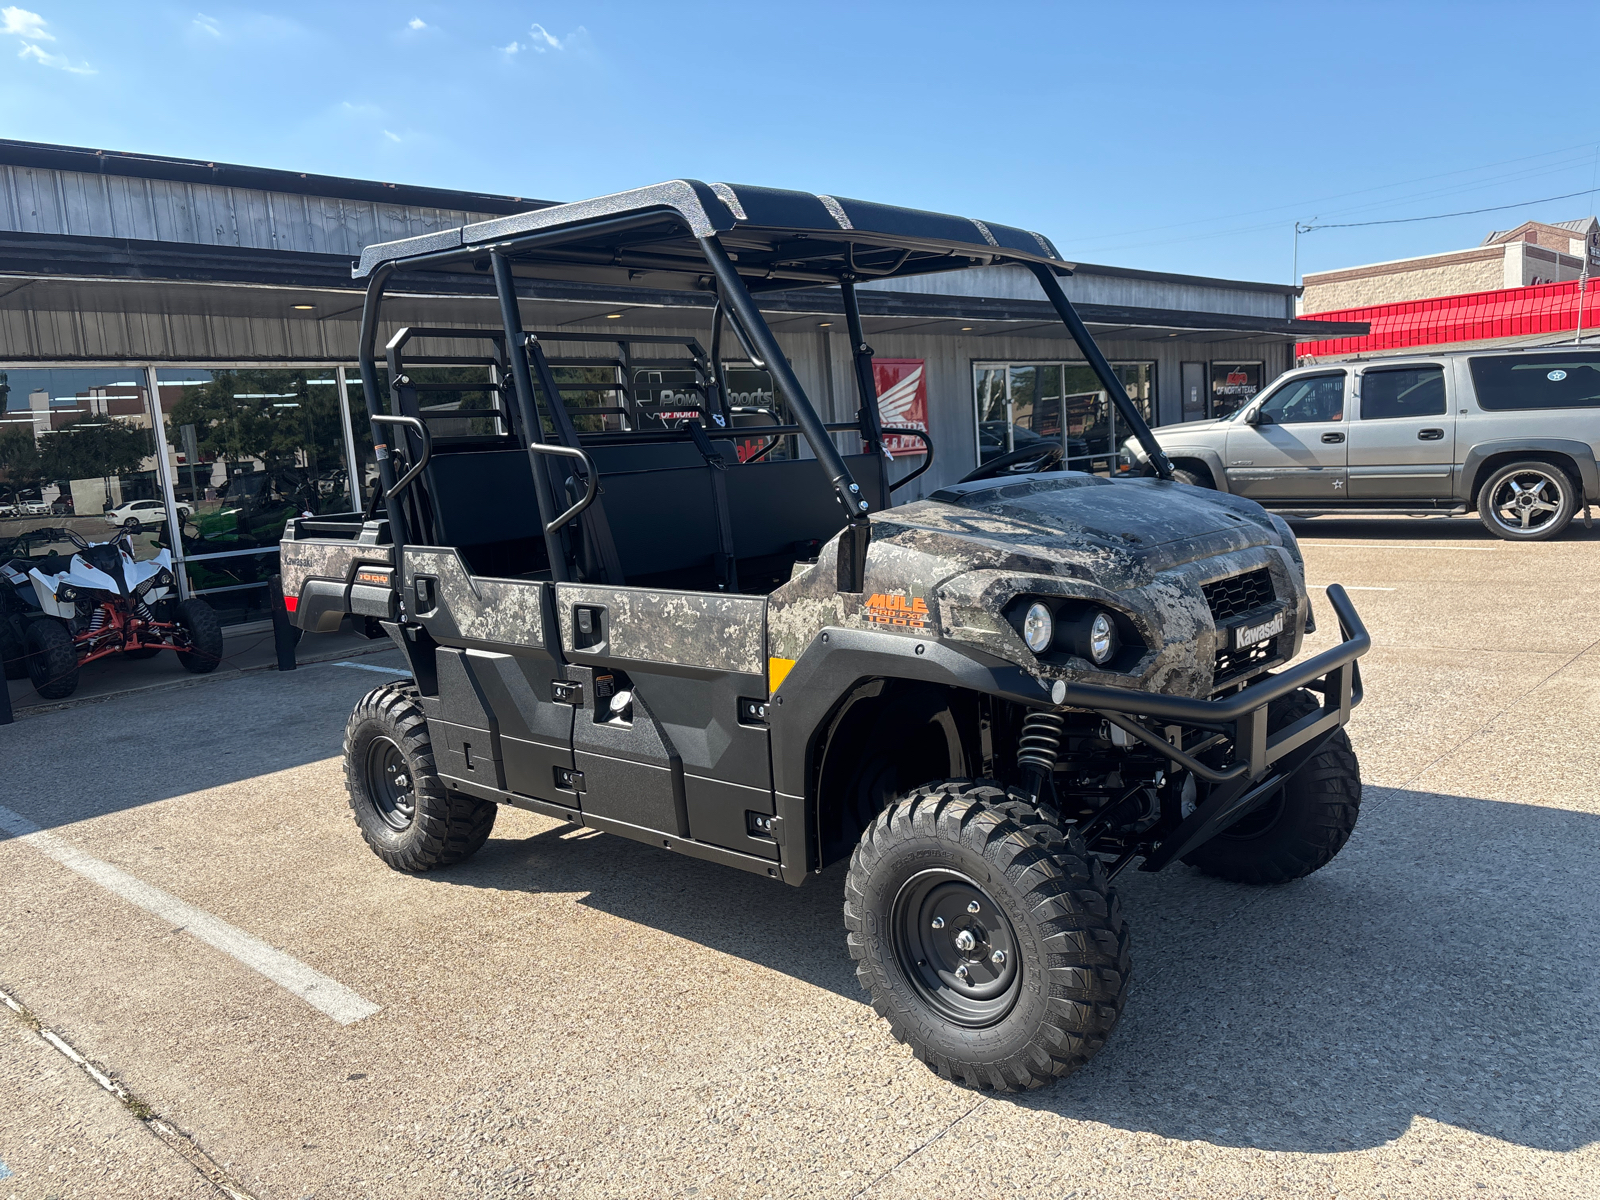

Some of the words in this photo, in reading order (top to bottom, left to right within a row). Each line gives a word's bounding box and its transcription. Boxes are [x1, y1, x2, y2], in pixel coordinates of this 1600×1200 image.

[1217, 387, 1224, 395] OF
[1224, 386, 1241, 395] NORTH
[1242, 385, 1257, 394] TEXAS
[284, 554, 312, 567] Kawasaki
[359, 573, 388, 583] 1000
[865, 593, 929, 614] MULE
[868, 615, 924, 627] 1000
[1236, 612, 1284, 649] Kawasaki
